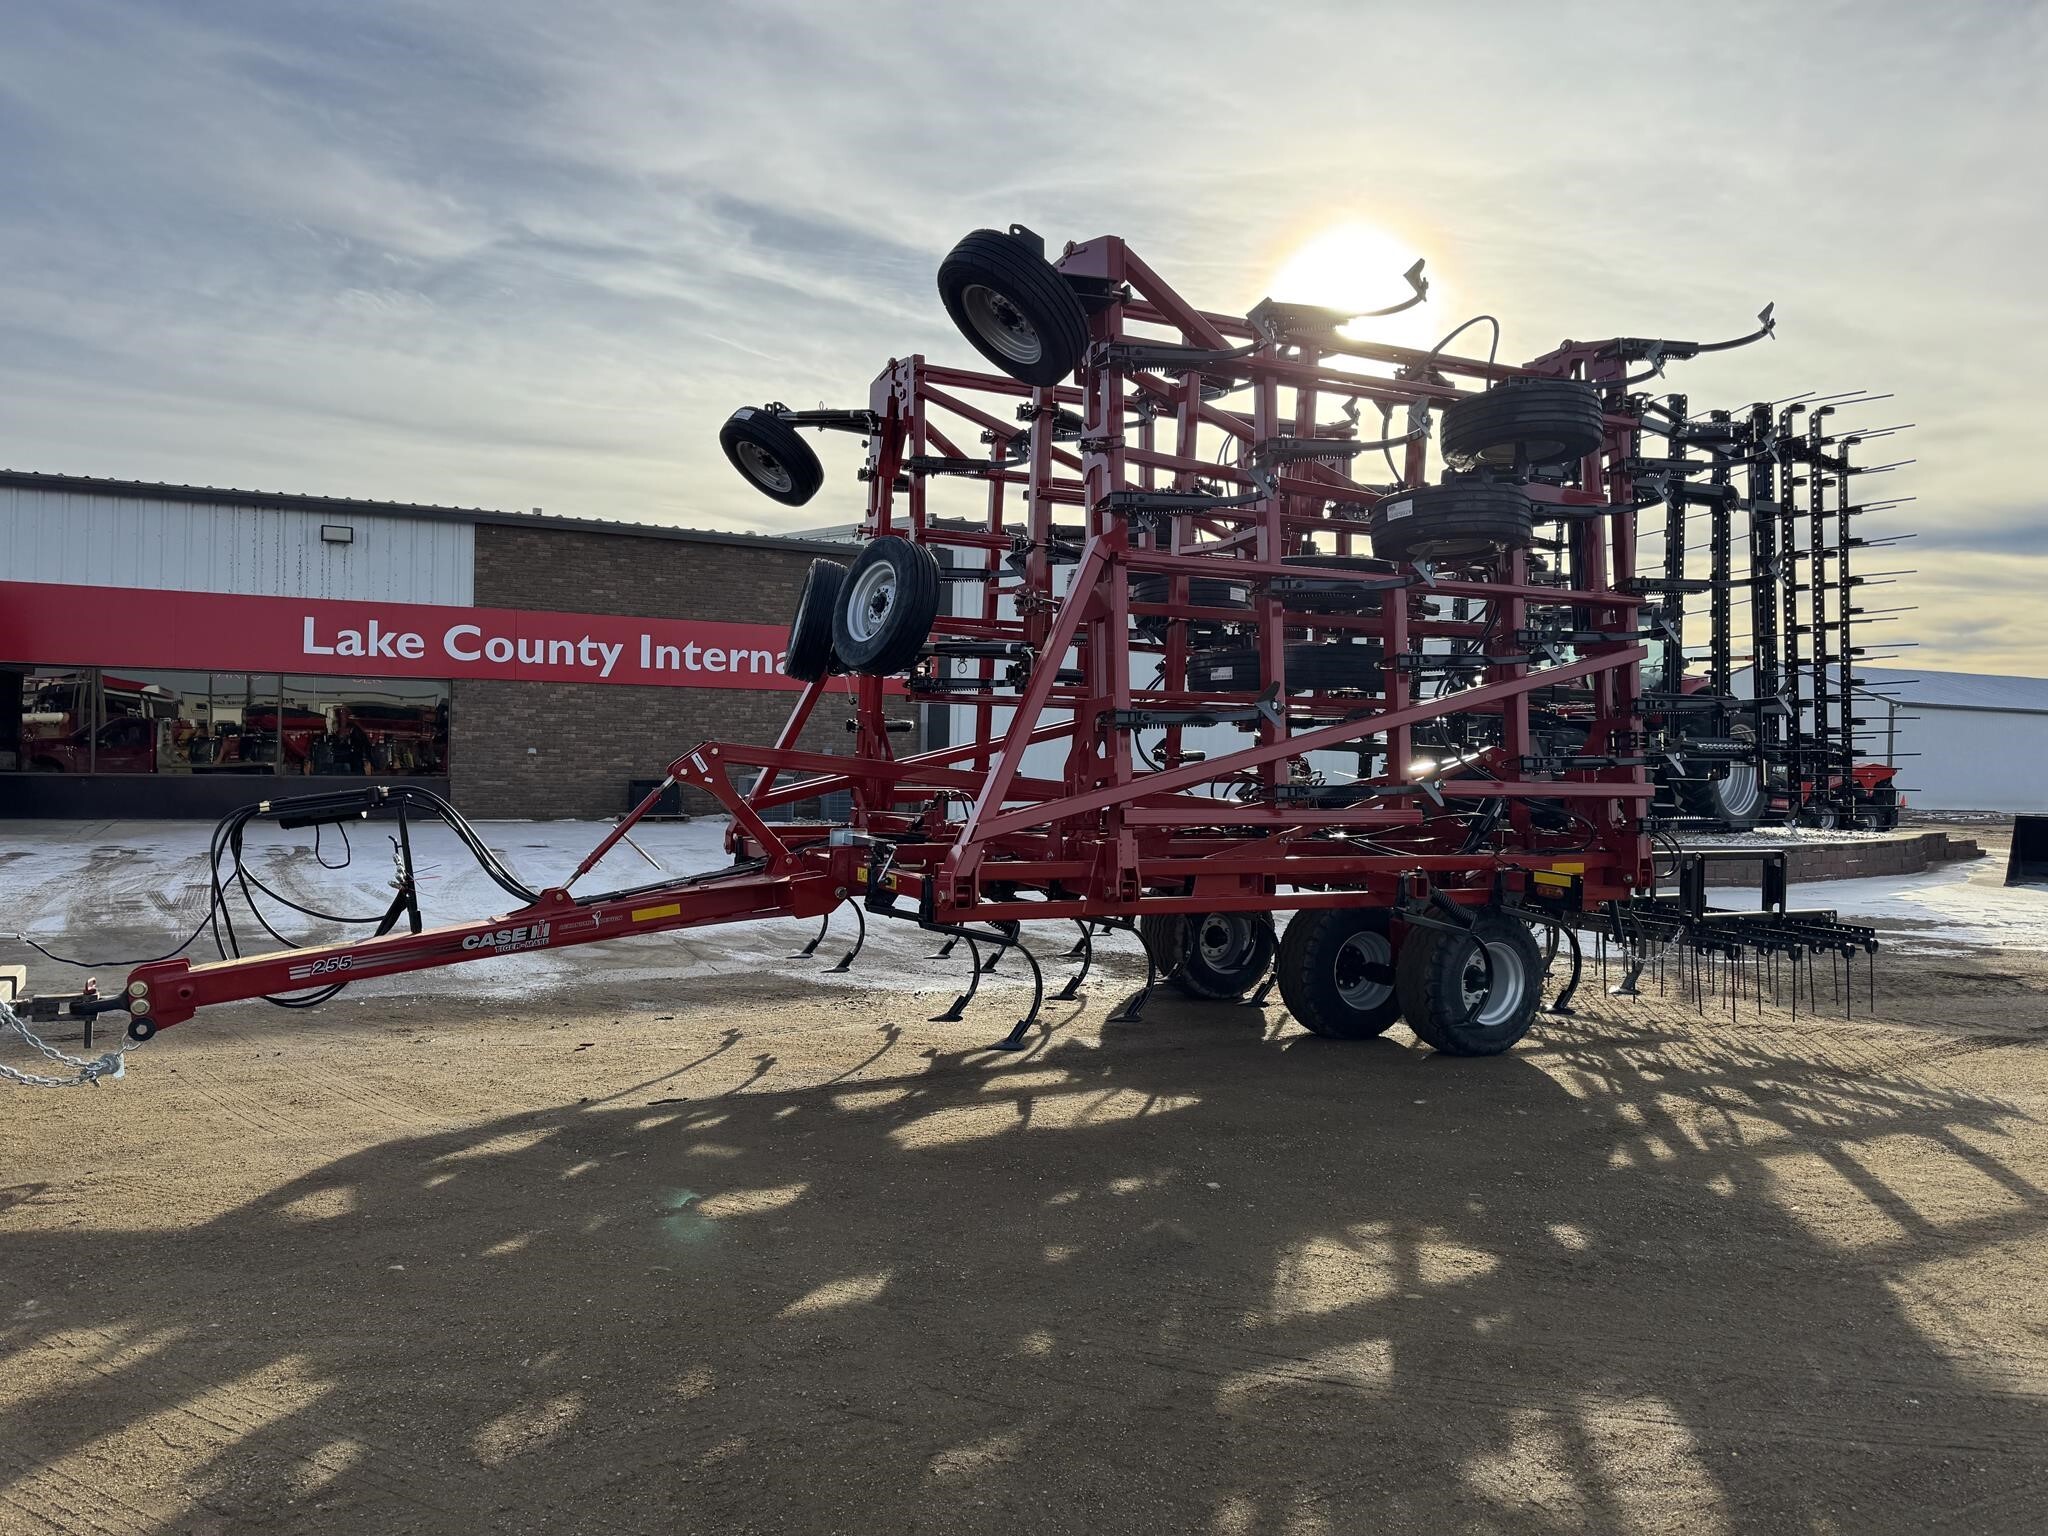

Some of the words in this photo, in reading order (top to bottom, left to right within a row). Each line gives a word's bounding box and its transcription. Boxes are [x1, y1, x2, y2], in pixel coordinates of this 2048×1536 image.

[302, 615, 425, 659] Lake
[442, 623, 624, 678] County
[462, 926, 528, 950] CASE
[311, 954, 353, 975] 255
